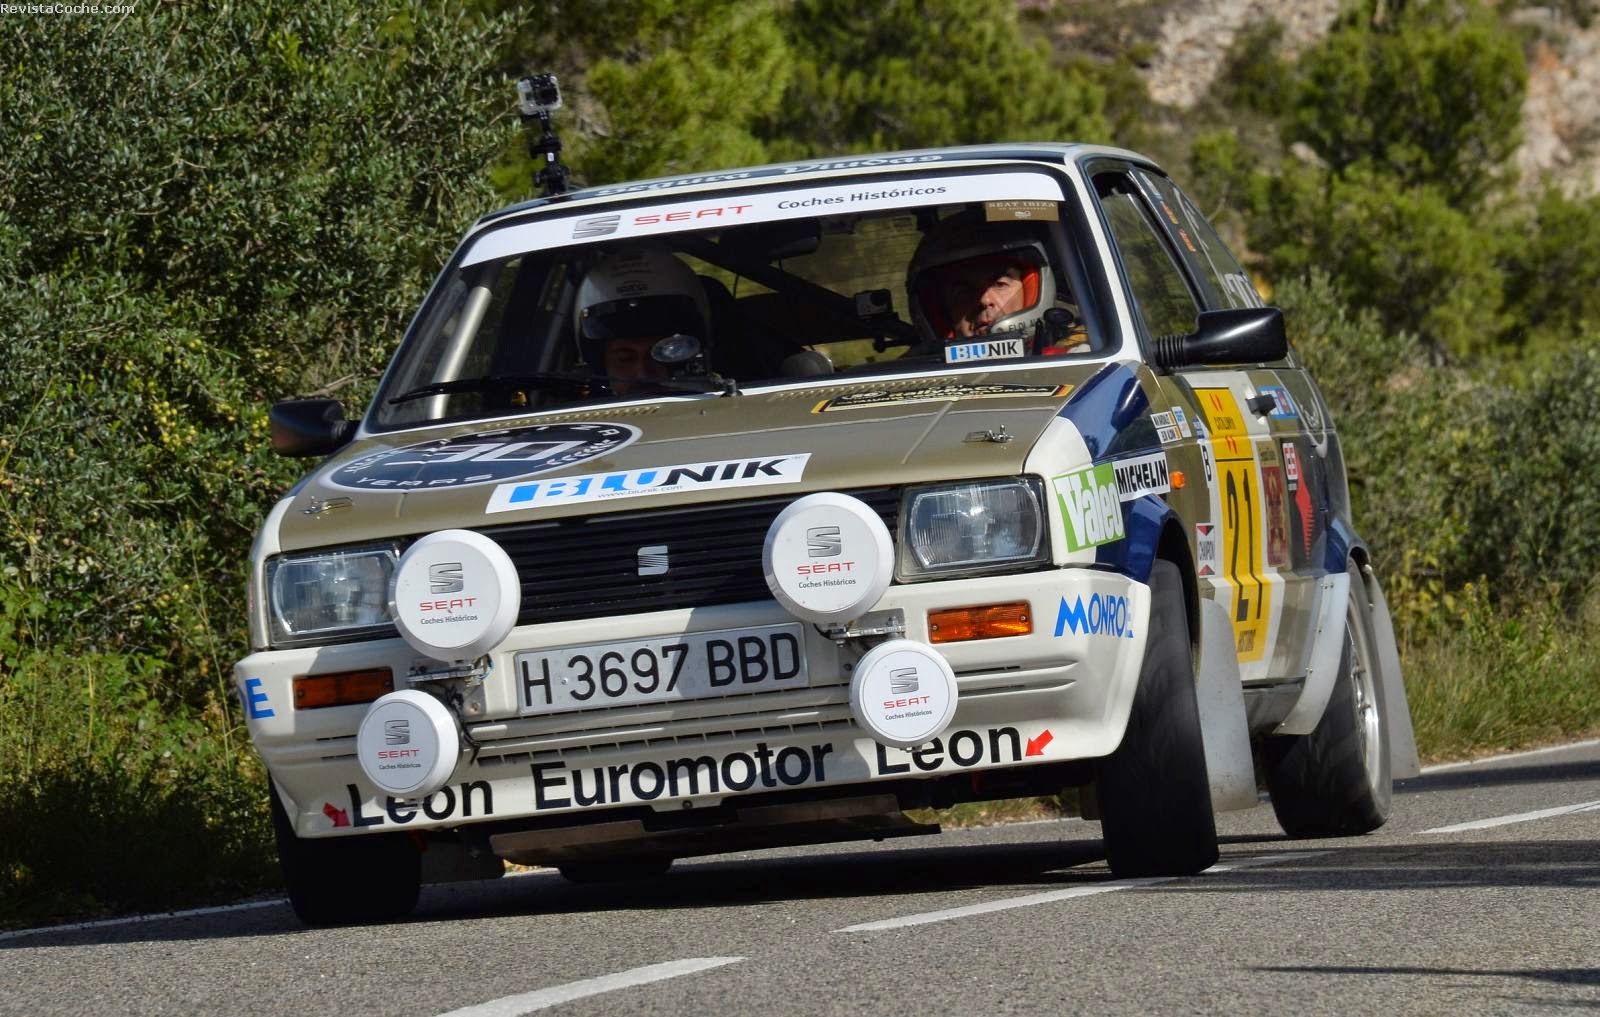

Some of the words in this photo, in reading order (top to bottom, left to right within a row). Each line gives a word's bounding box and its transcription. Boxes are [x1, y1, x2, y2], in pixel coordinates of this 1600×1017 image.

[634, 205, 753, 226] SEAT
[777, 194, 844, 210] Coches
[850, 185, 947, 202] Históricos
[949, 341, 1018, 361] BLUNIK
[384, 440, 588, 467] 30
[356, 473, 494, 487] YEARS
[508, 458, 787, 503] BLUNIK
[1115, 459, 1169, 495] MICHELIN
[1053, 470, 1126, 548] Valeo
[1226, 468, 1263, 623] 21
[797, 562, 854, 575] SEAT
[798, 580, 822, 589] Coches
[823, 578, 856, 587] Históricos
[420, 598, 477, 611] SEAT
[420, 616, 444, 625] Coches
[445, 614, 478, 624] Históricos
[521, 658, 553, 707] H
[567, 643, 689, 701] 3697
[706, 632, 801, 688] BBD
[883, 696, 930, 709] SEAT
[885, 713, 905, 721] Coches
[905, 709, 932, 718] Históricos
[377, 749, 421, 759] SEAT
[530, 742, 833, 811] Euromotor
[876, 725, 1023, 776] Leon
